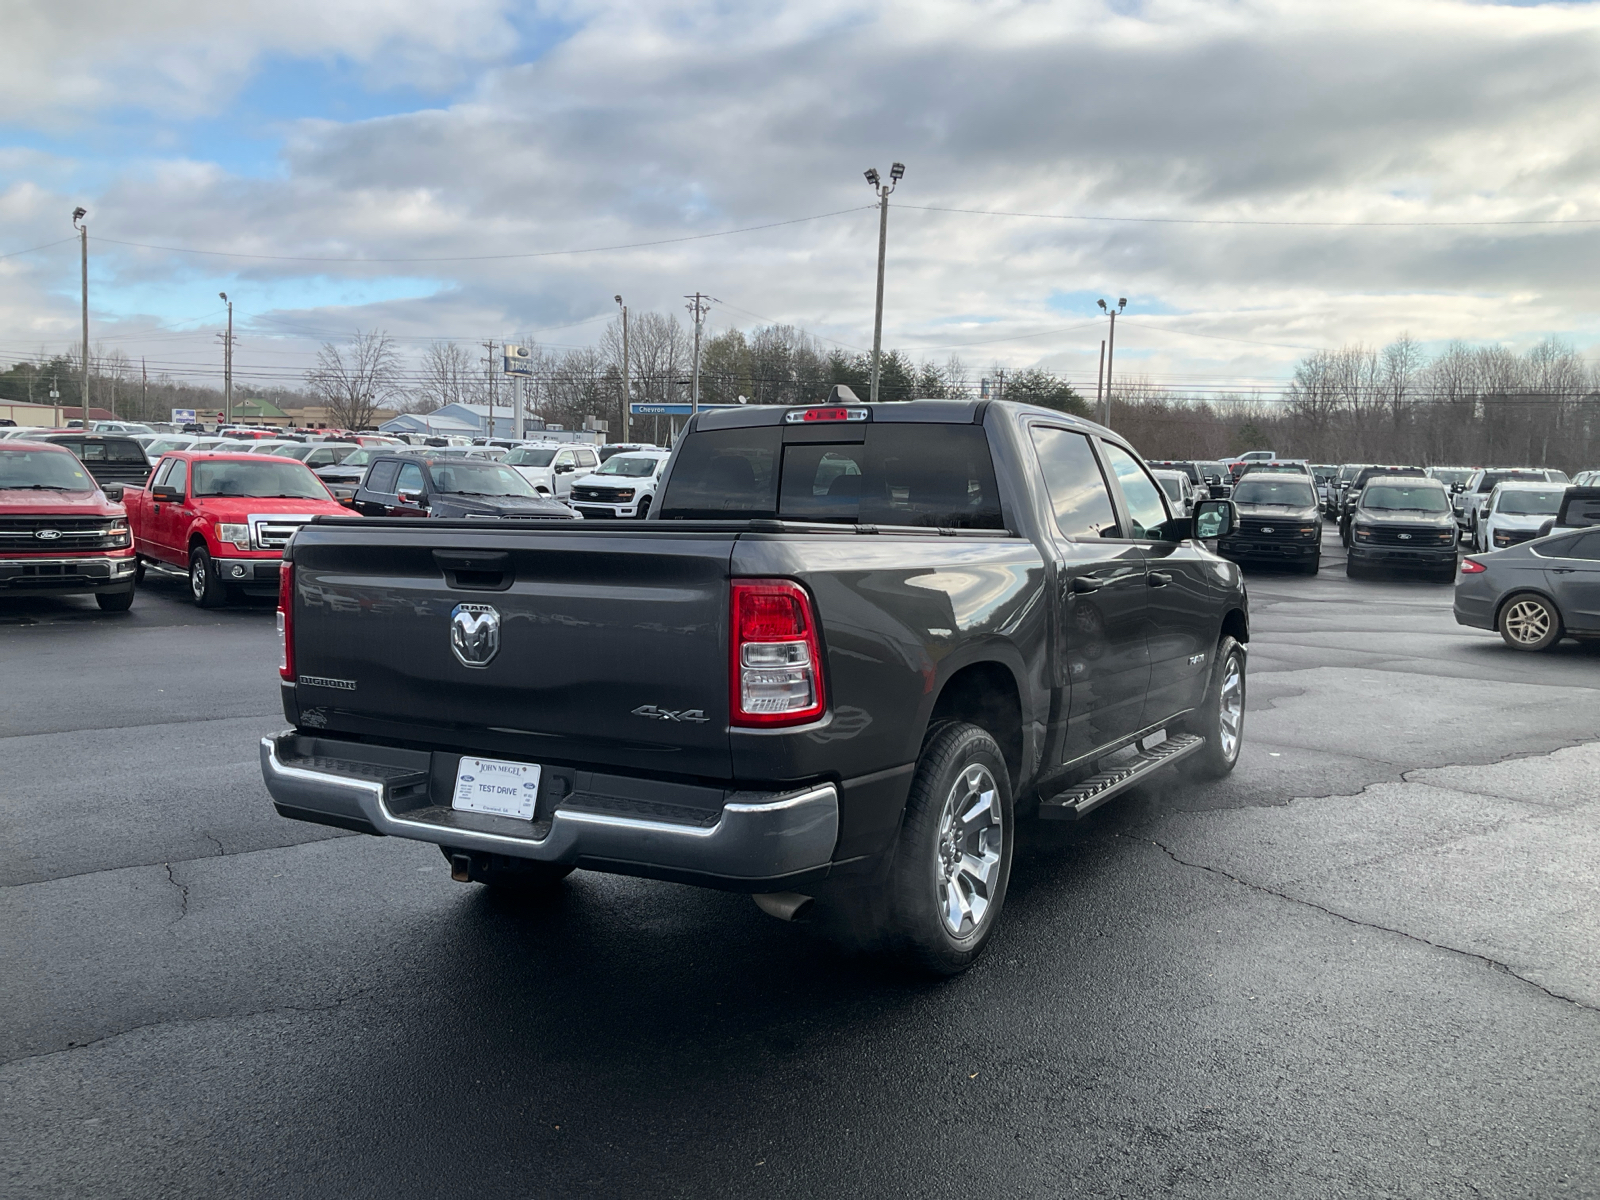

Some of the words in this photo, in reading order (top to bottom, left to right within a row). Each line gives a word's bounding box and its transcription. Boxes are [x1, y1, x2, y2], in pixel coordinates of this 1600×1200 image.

[479, 764, 497, 772] JOHN
[498, 766, 521, 776] MEGEL
[479, 784, 496, 792] TEST
[497, 786, 517, 796] DRIVE
